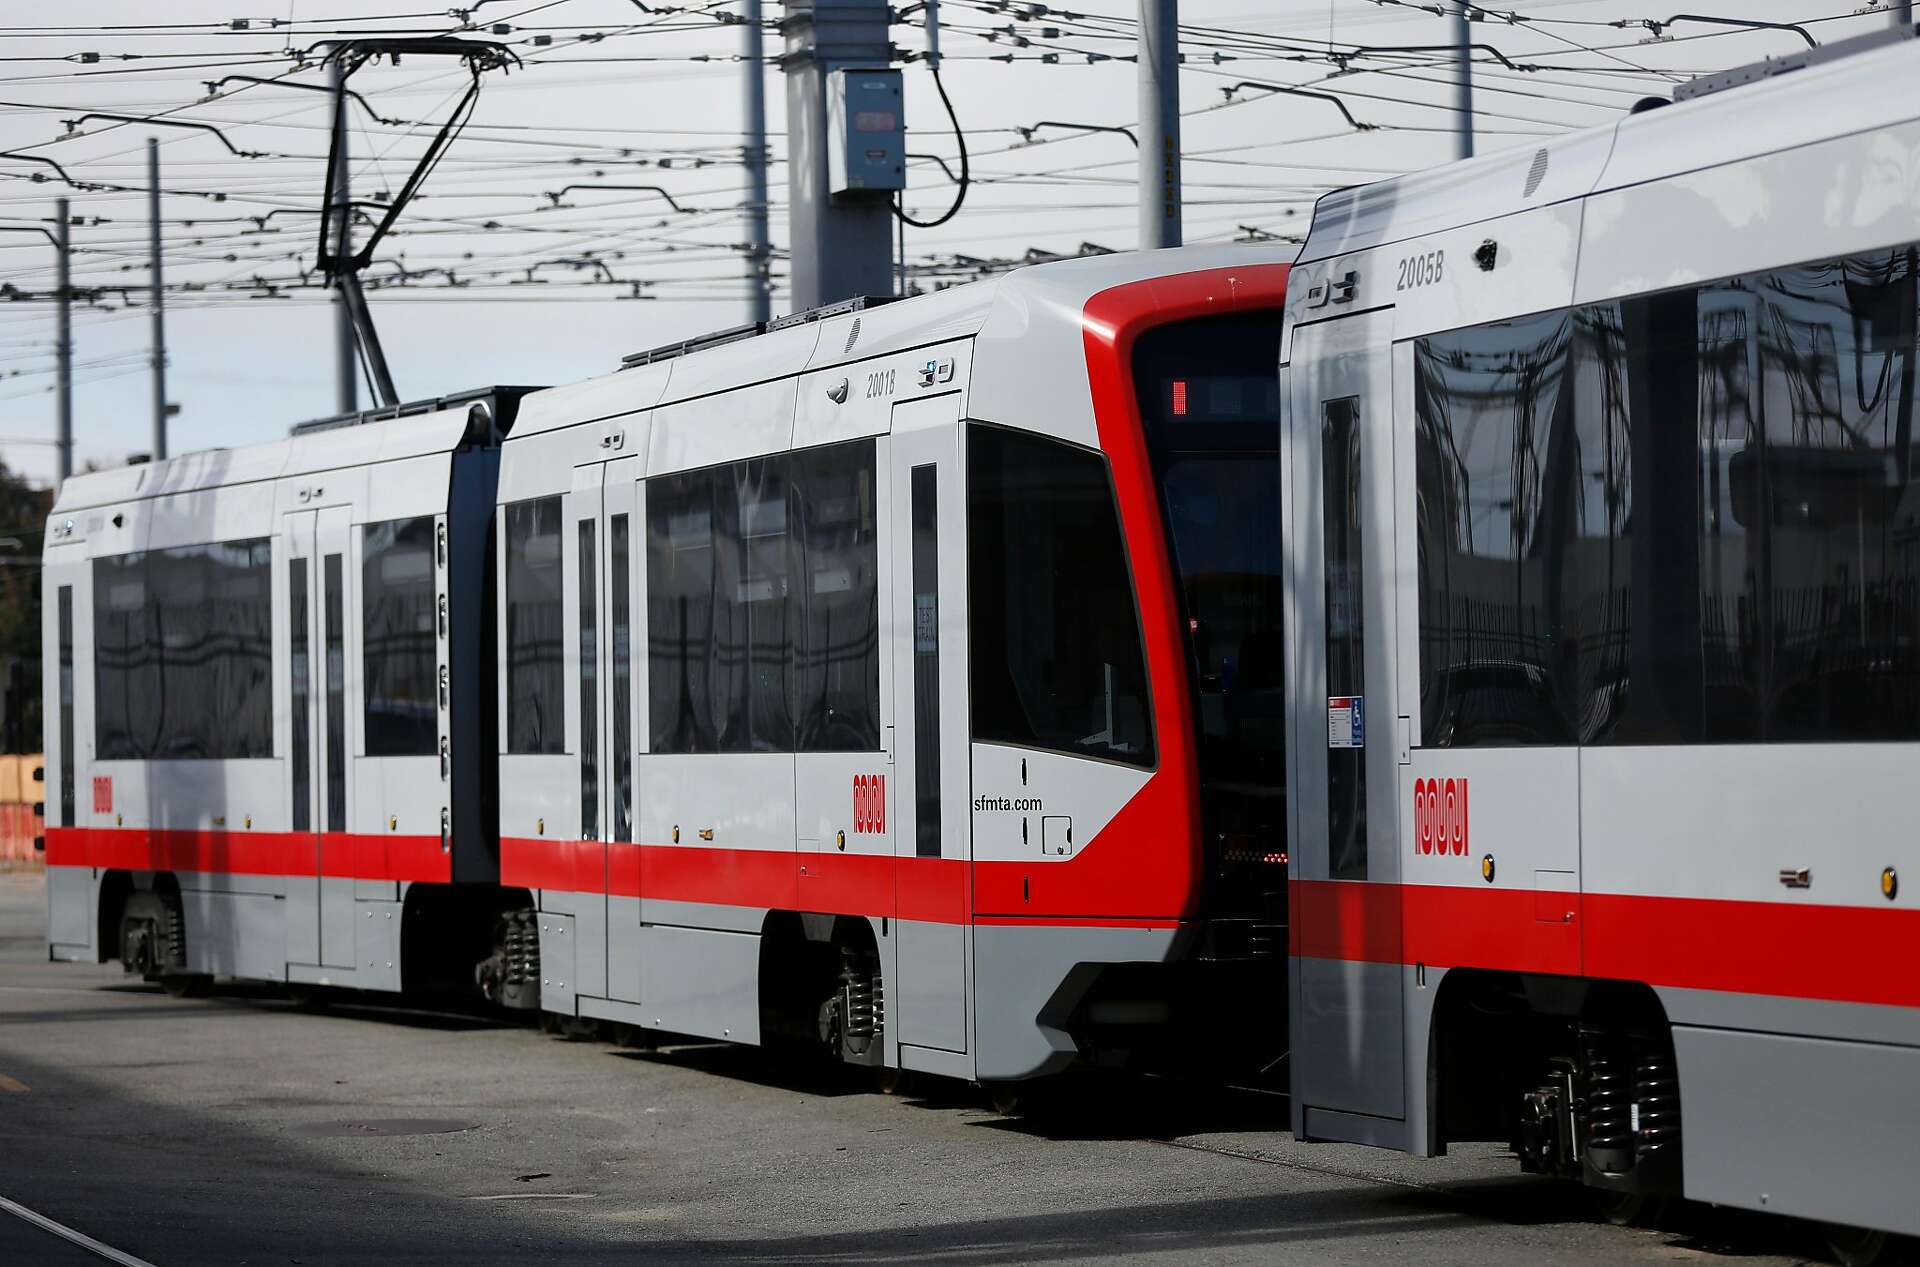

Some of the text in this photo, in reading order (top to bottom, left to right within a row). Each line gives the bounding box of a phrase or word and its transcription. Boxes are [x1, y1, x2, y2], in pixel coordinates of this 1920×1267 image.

[1397, 250, 1444, 291] 2005B
[867, 369, 895, 398] 2001B
[974, 794, 1042, 811] sfmta.com
